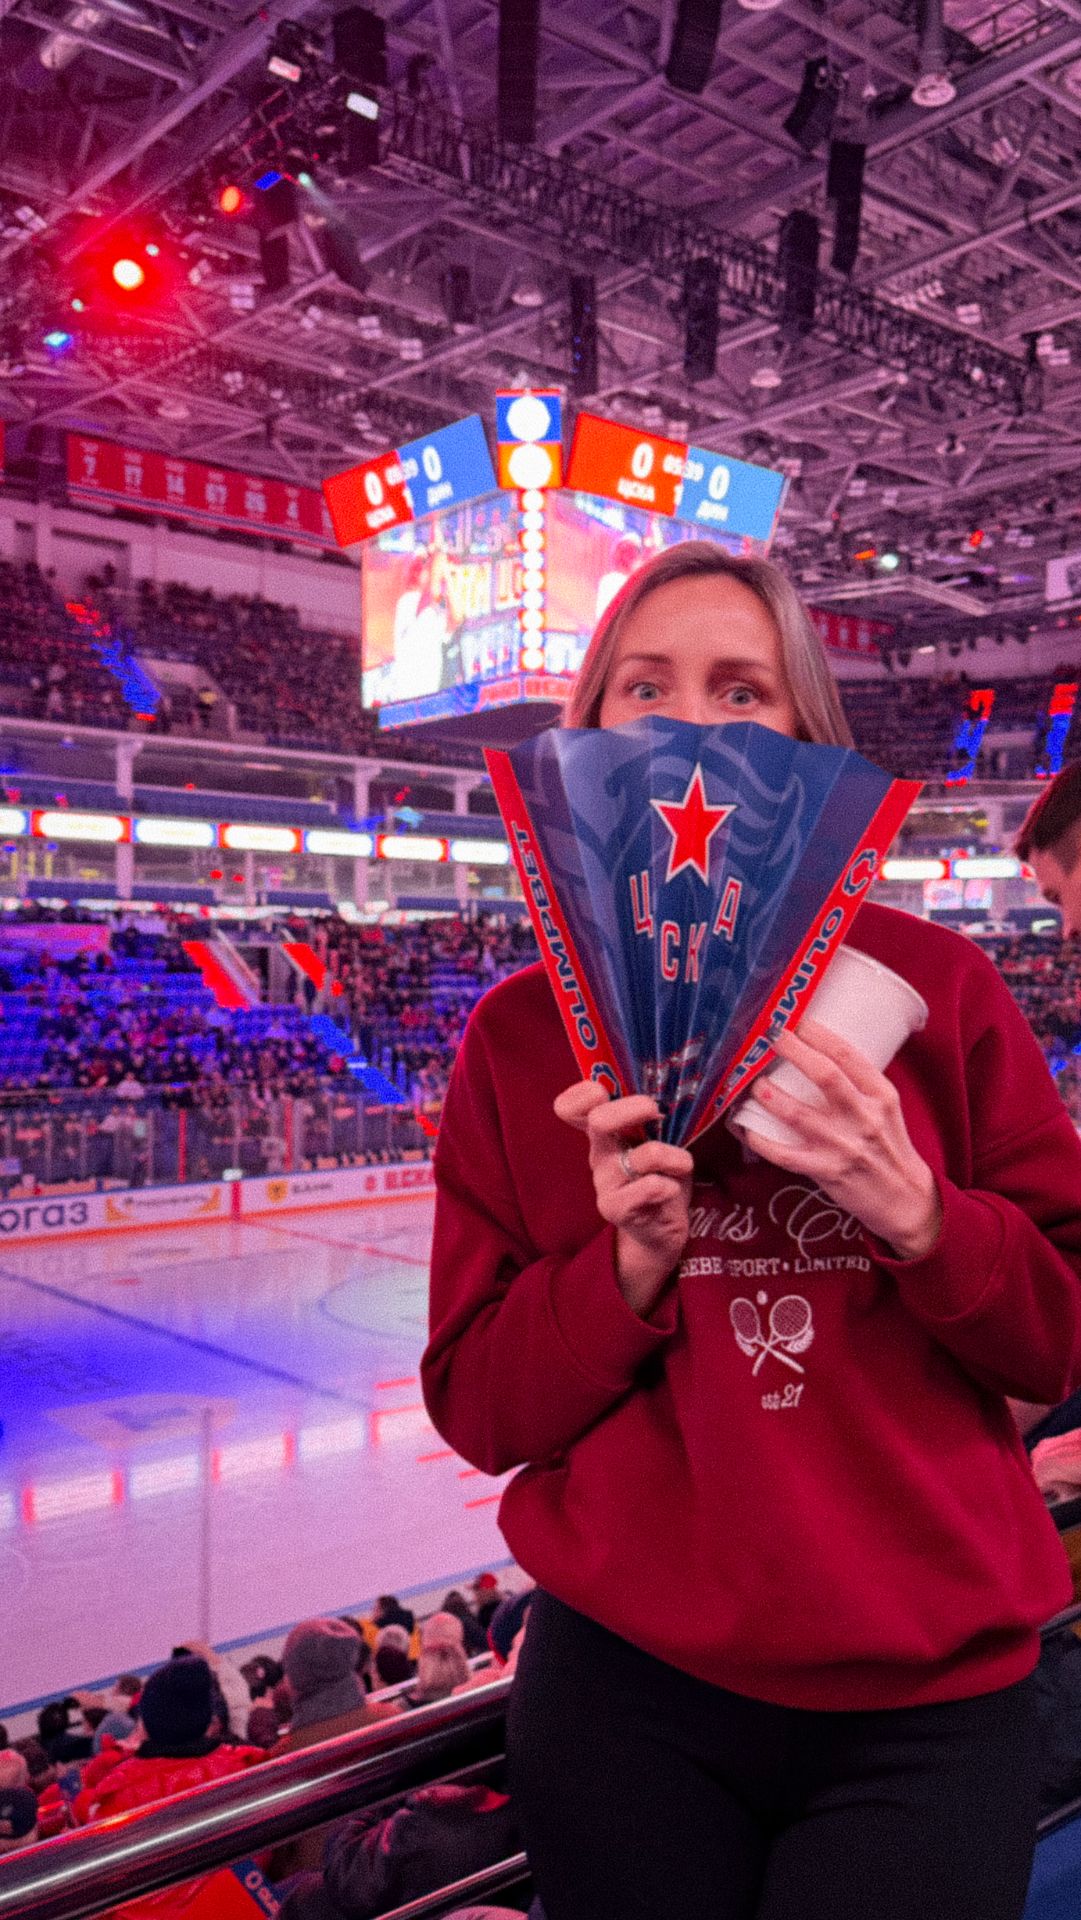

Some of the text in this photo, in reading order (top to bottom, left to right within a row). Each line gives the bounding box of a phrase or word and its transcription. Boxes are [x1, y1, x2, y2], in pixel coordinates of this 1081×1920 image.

[364, 471, 384, 506] 0
[422, 445, 442, 482] 0
[631, 442, 654, 478] 0
[708, 465, 730, 500] 0
[674, 484, 684, 505] 1
[511, 820, 599, 1051] OLIMPBET
[629, 869, 742, 983] ЦСКА
[780, 1382, 804, 1408] 21
